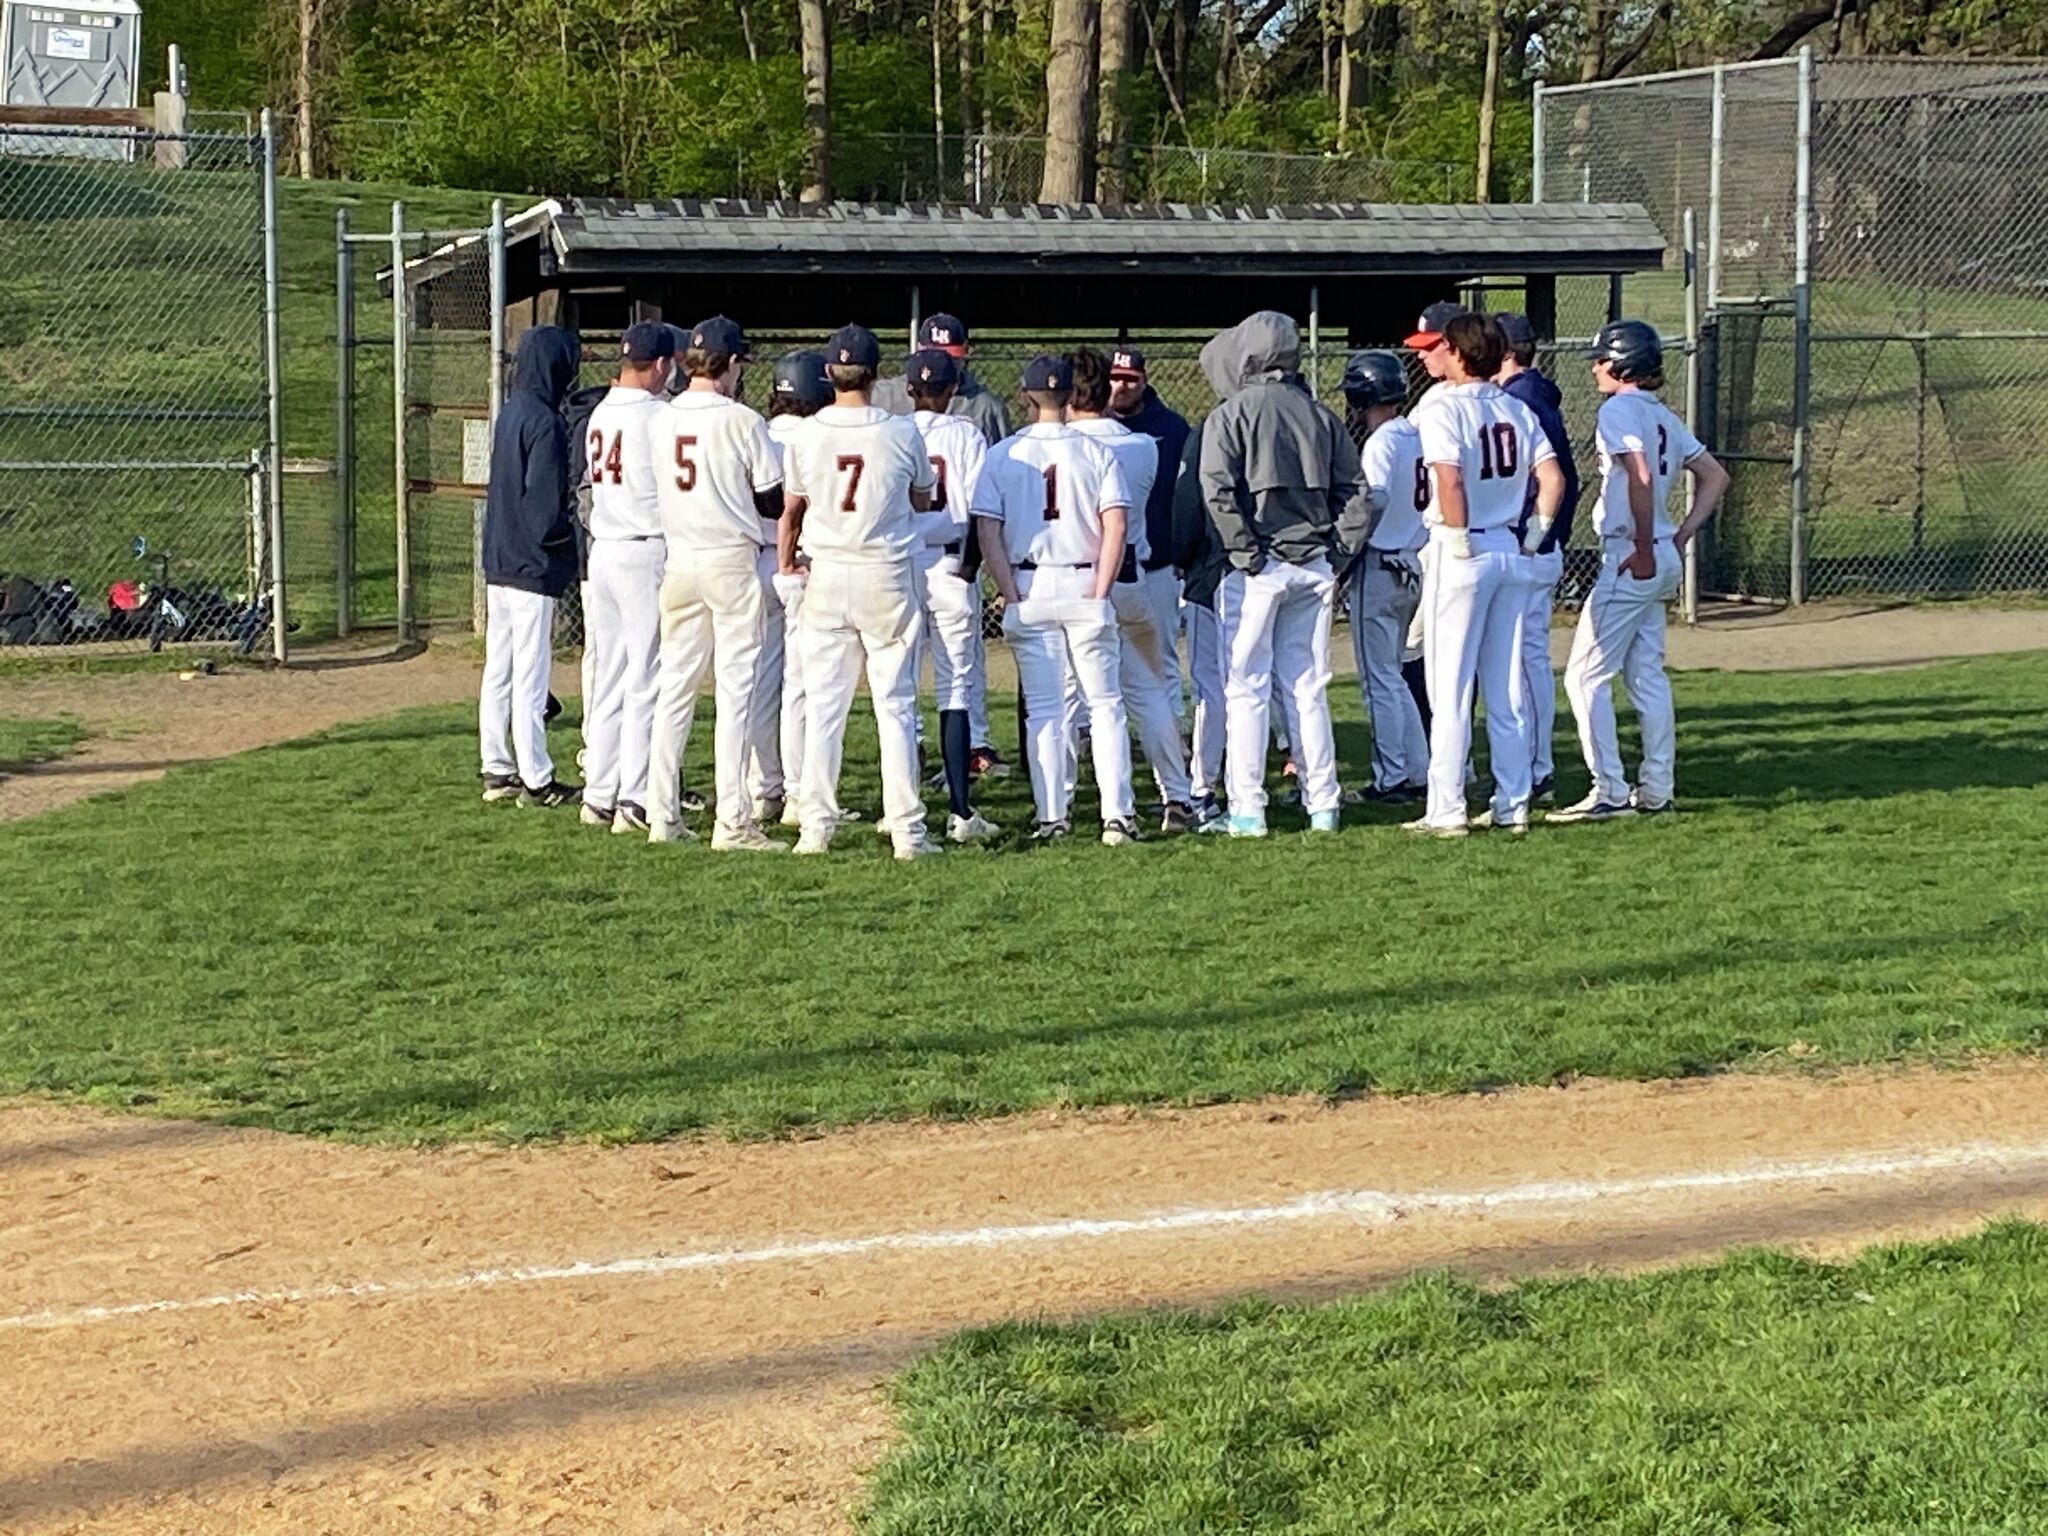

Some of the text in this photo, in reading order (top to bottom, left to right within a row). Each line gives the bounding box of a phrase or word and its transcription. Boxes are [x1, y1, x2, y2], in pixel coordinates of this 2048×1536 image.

[590, 429, 623, 485] 24
[675, 435, 698, 492] 5
[1478, 422, 1518, 480] 10
[836, 454, 865, 512] 7
[1042, 463, 1060, 521] 1
